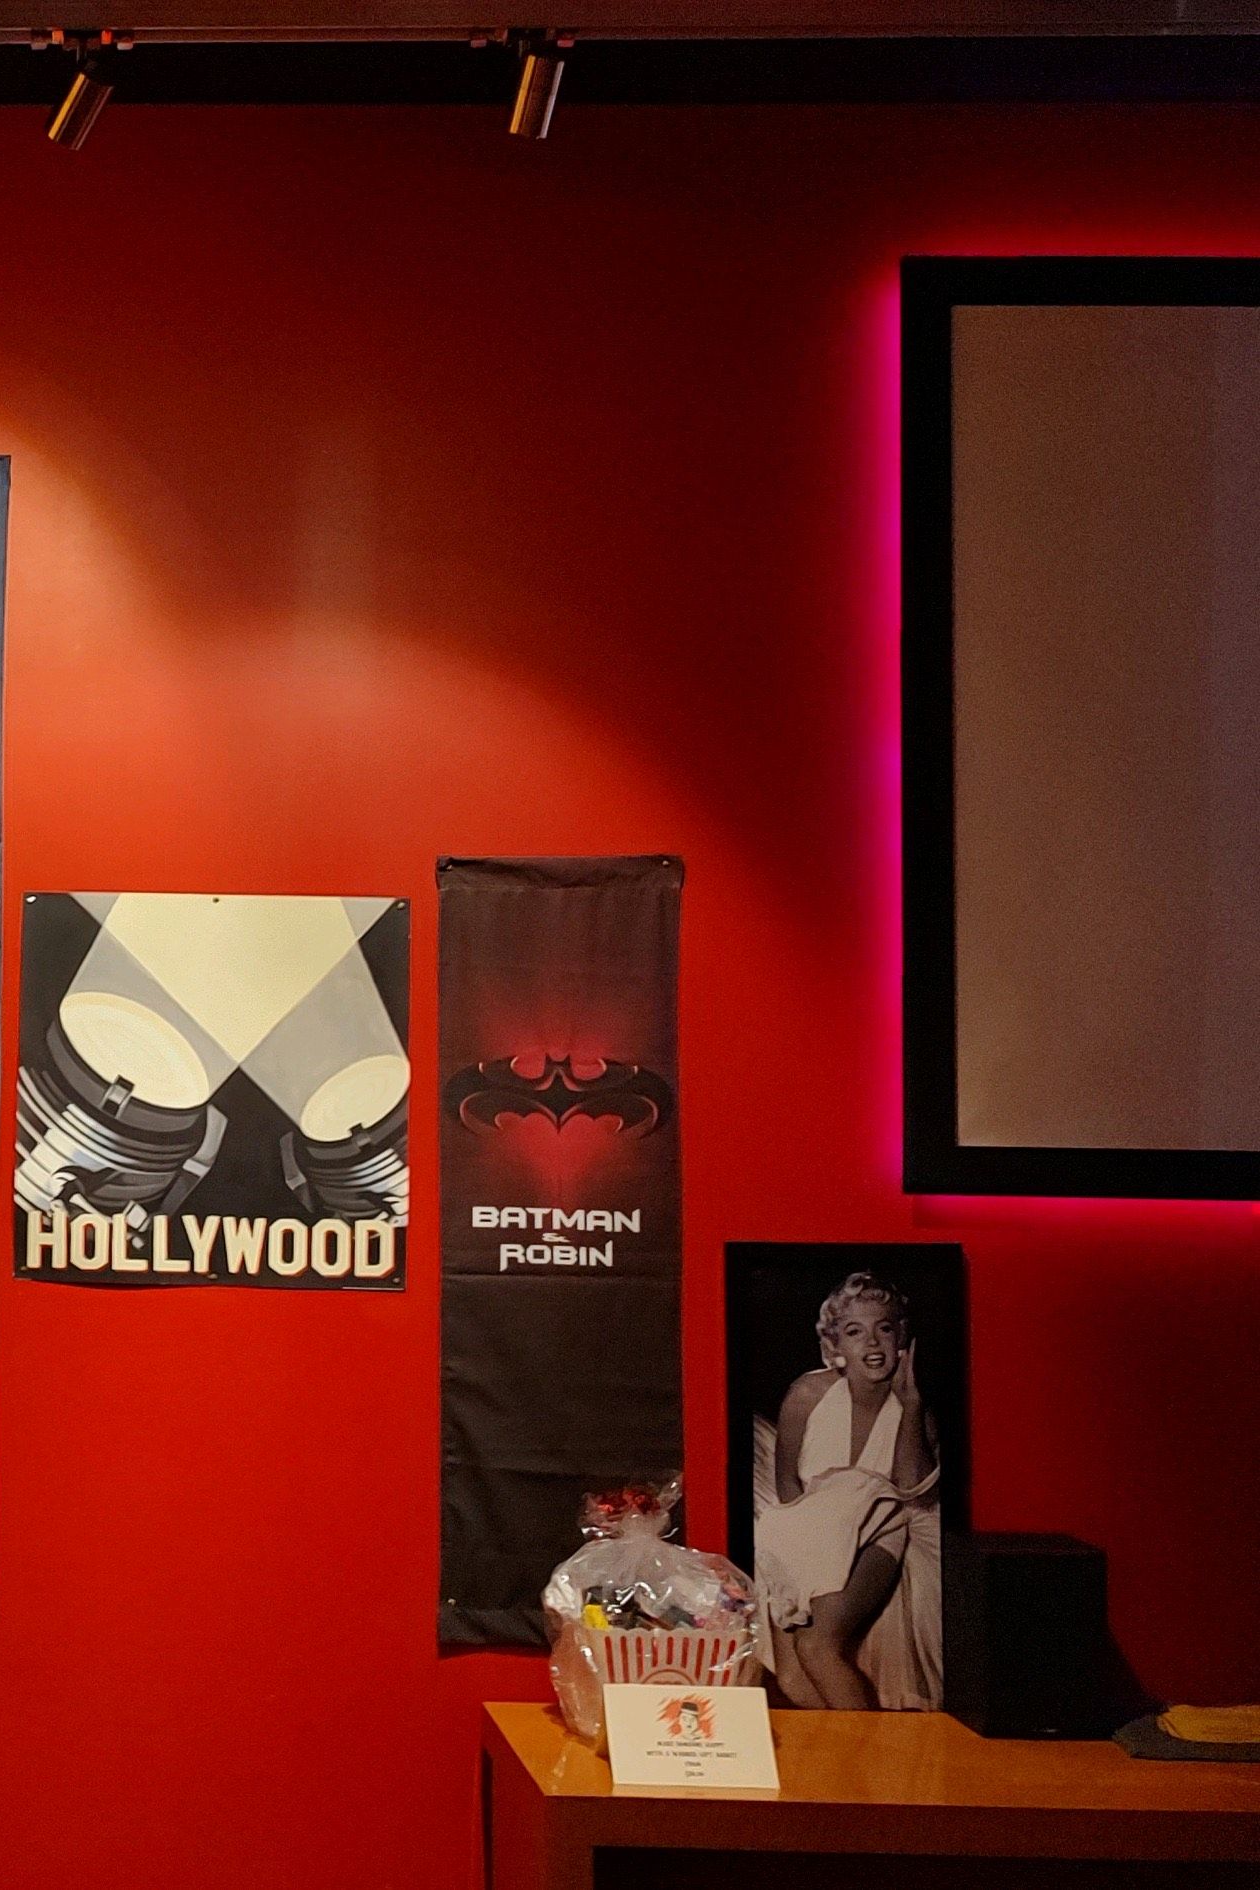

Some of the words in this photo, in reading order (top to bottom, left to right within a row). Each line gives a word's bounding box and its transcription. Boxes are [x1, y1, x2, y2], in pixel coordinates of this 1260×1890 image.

[472, 1206, 641, 1233] BATMAN
[26, 1209, 395, 1278] HOLLYWOOD
[541, 1232, 571, 1243] &
[500, 1240, 614, 1272] ROBIN
